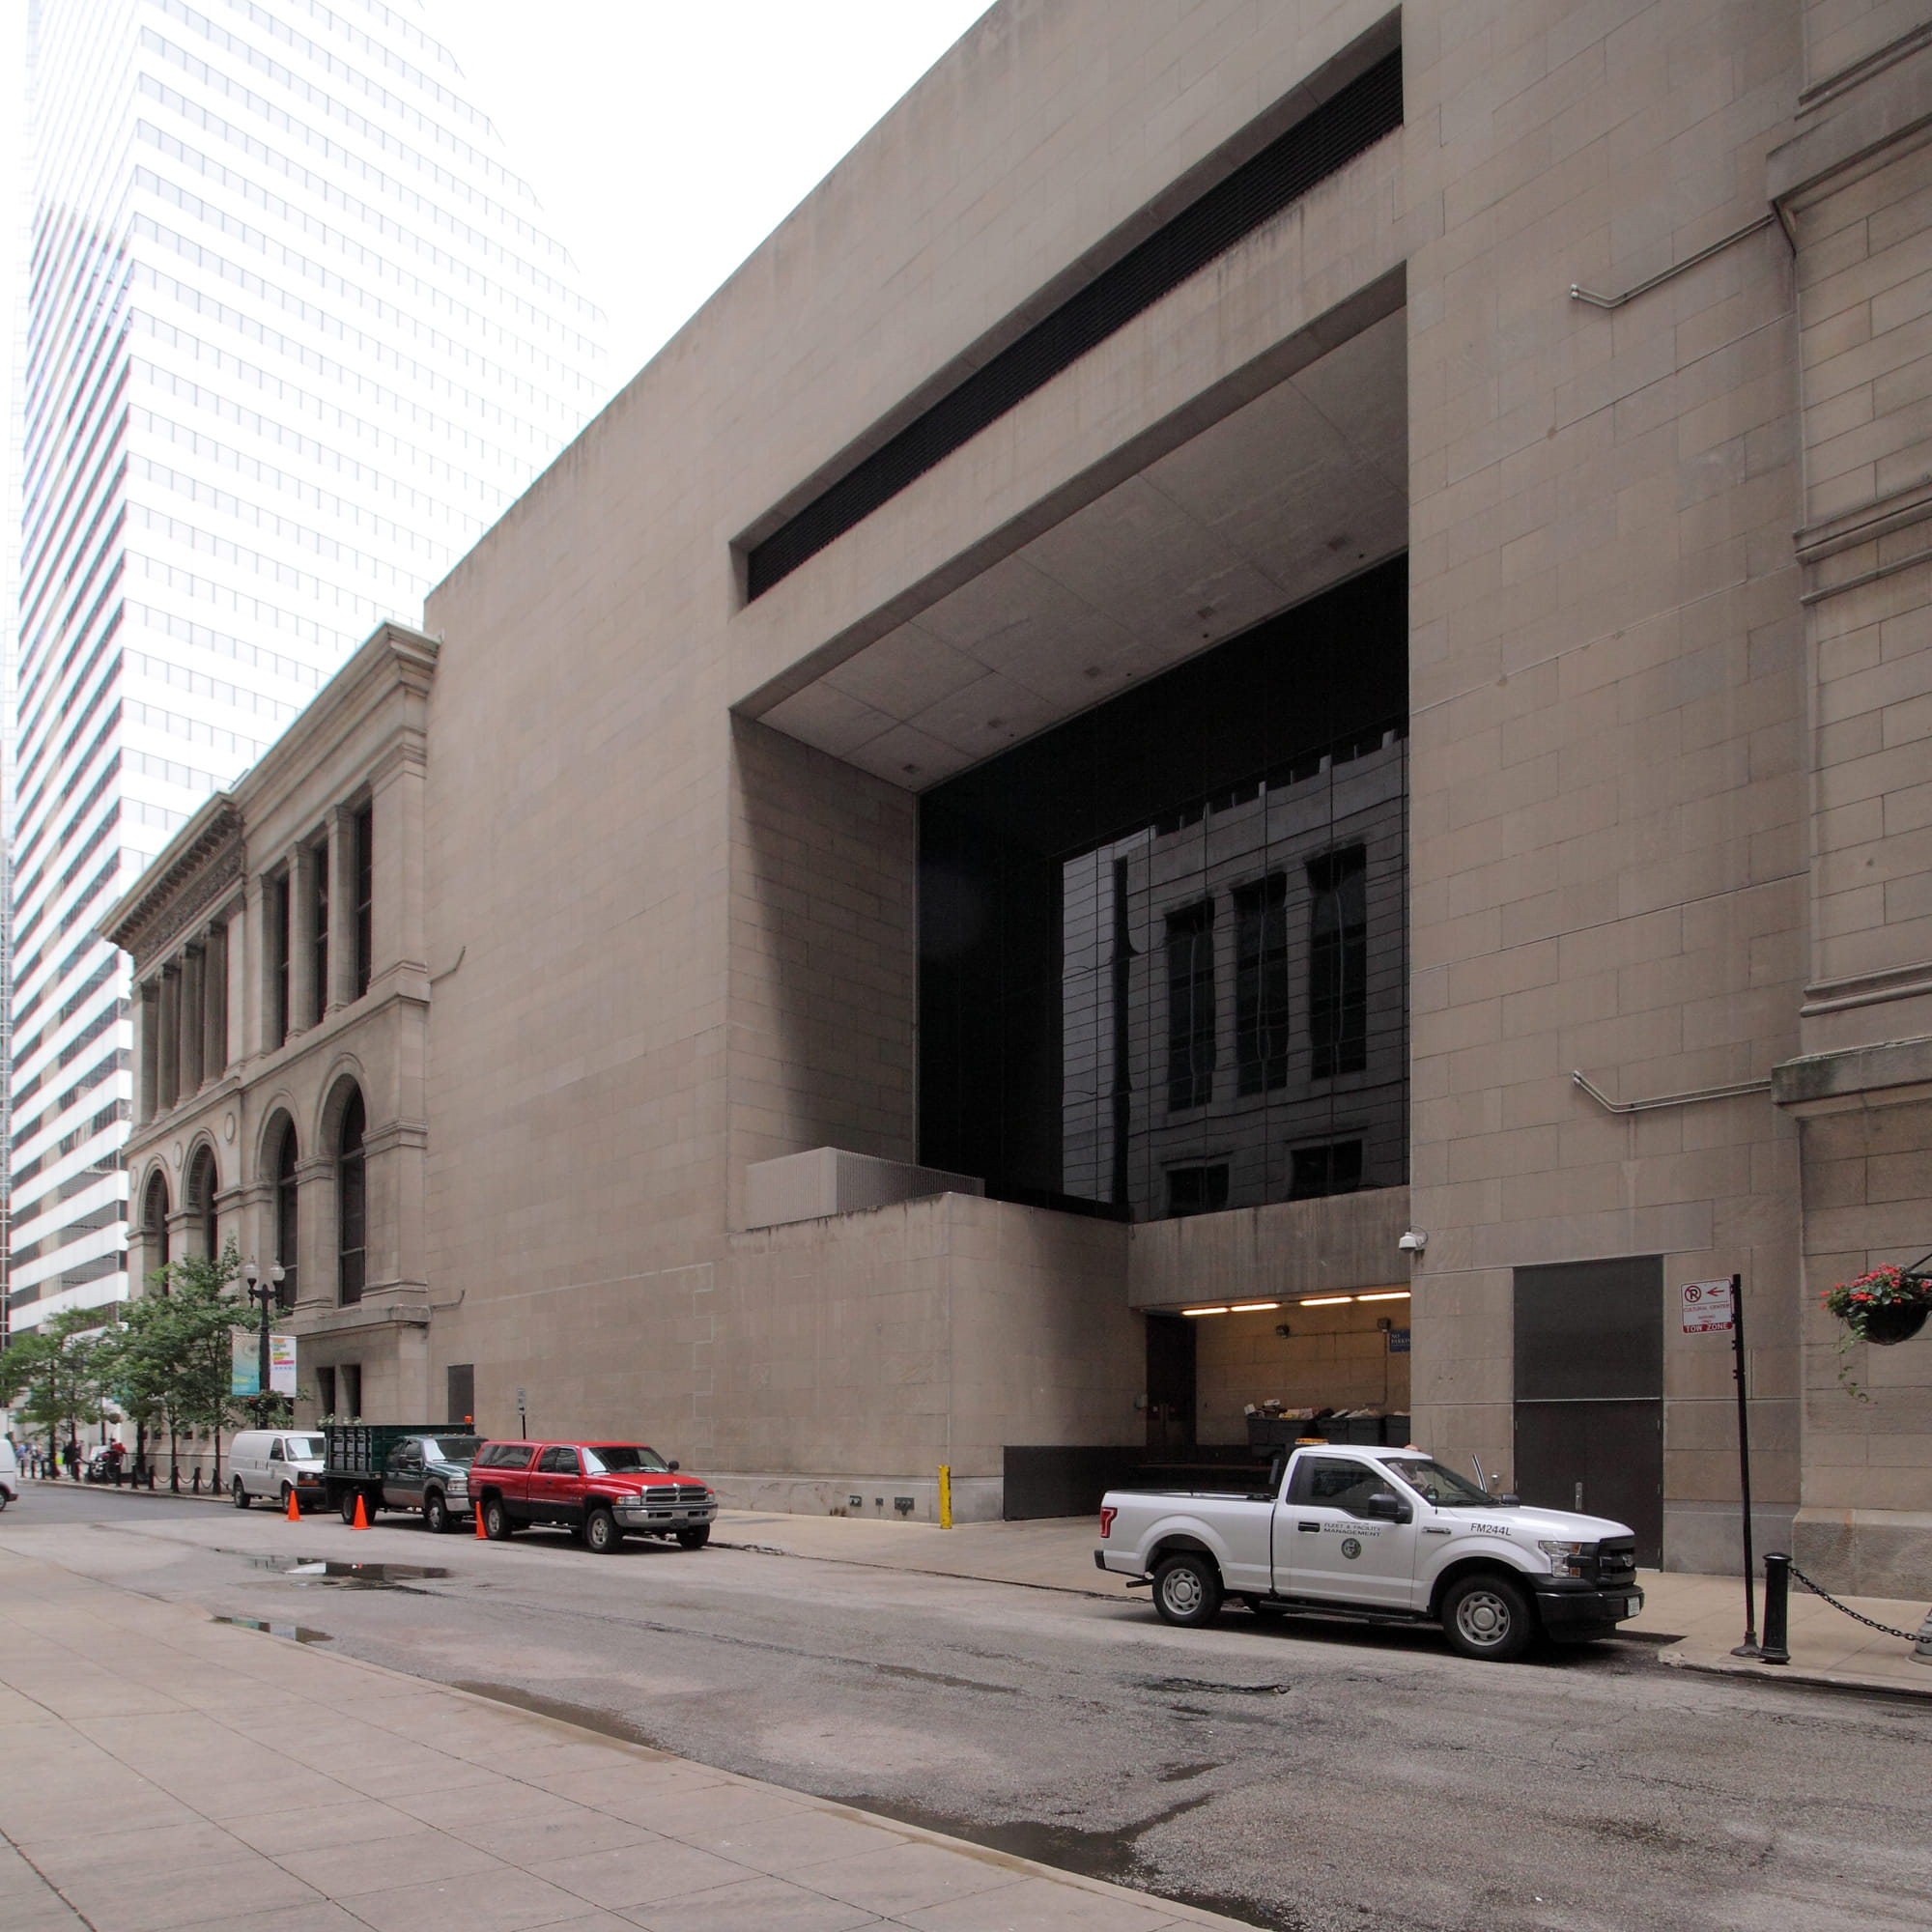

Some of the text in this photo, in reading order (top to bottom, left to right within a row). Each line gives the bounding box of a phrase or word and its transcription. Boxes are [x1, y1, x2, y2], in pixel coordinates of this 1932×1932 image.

[1686, 1322, 1729, 1333] TOW ZONE
[1470, 1522, 1511, 1536] FM244L
